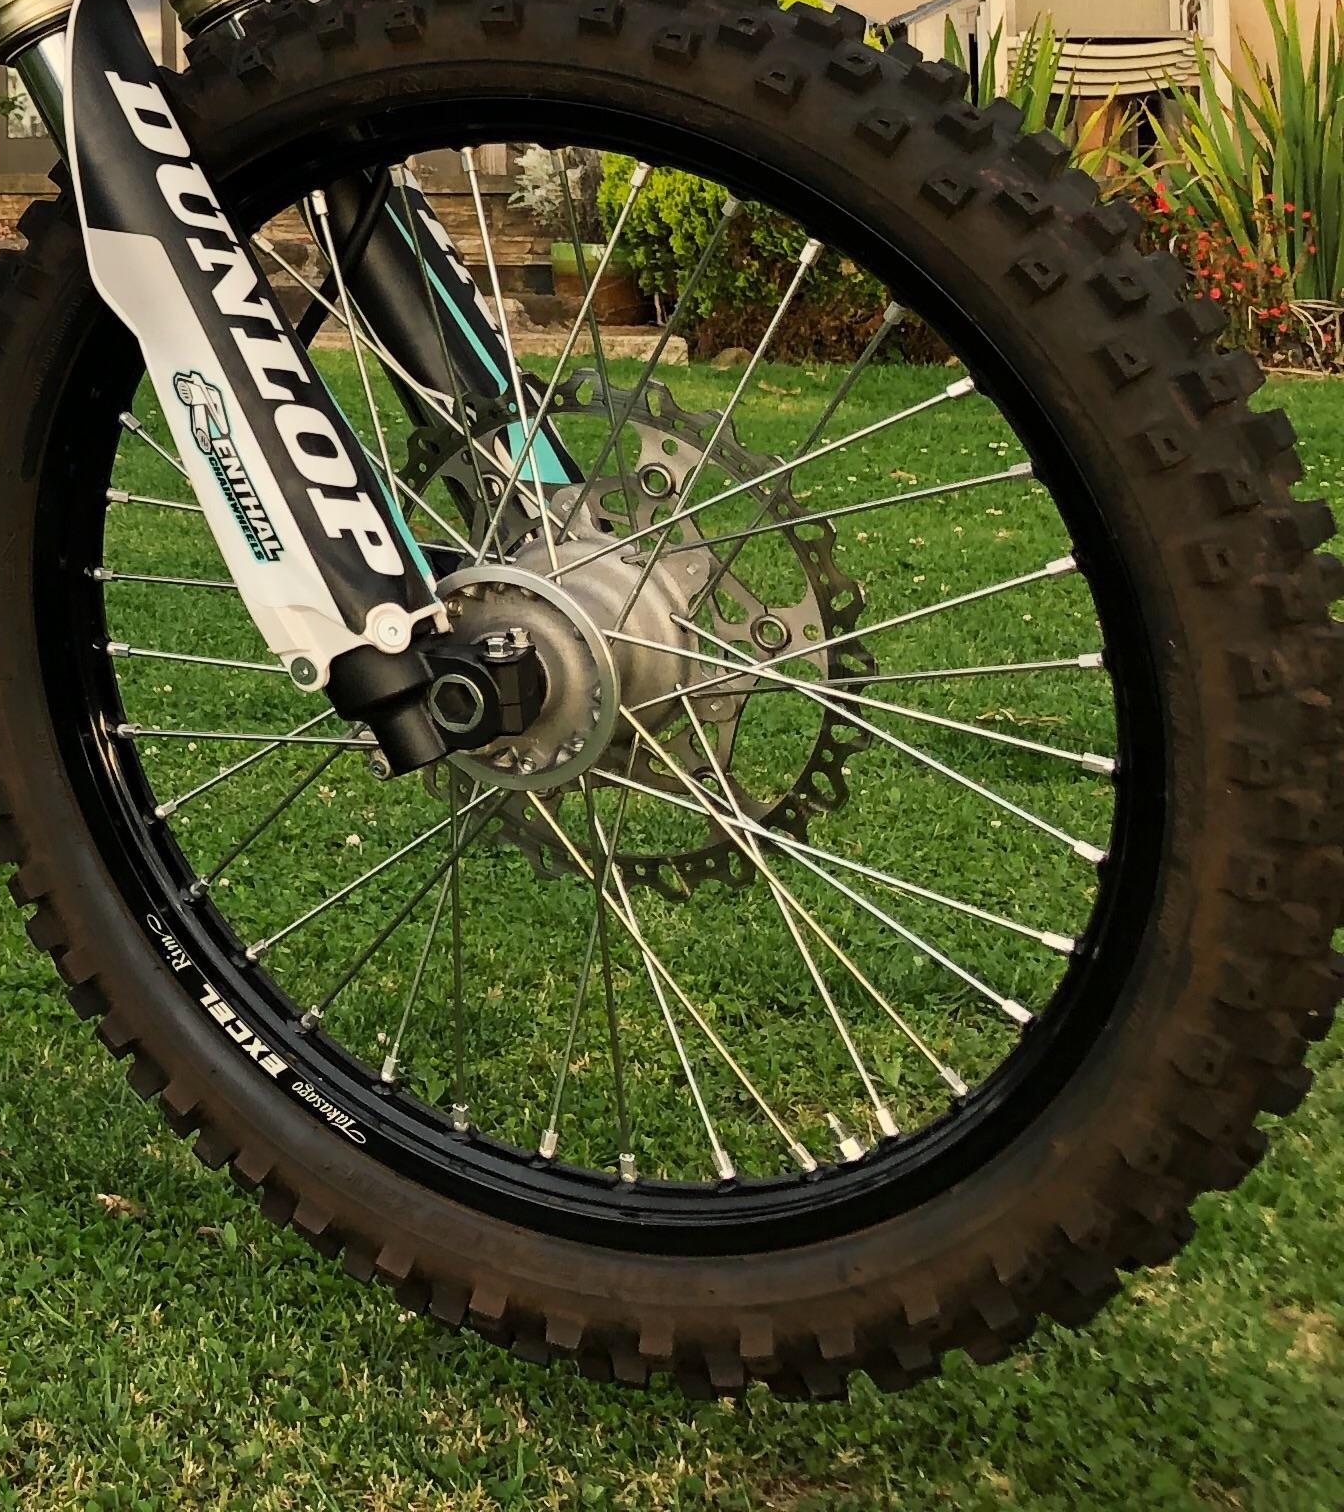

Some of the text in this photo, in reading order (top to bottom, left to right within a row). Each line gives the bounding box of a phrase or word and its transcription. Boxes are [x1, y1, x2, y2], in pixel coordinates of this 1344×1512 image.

[103, 69, 405, 577] DUNLOP
[174, 371, 284, 562] RENTHAL
[208, 456, 265, 561] CHAINWHEELS
[146, 913, 367, 1145] Takasago EXCEL Rim
